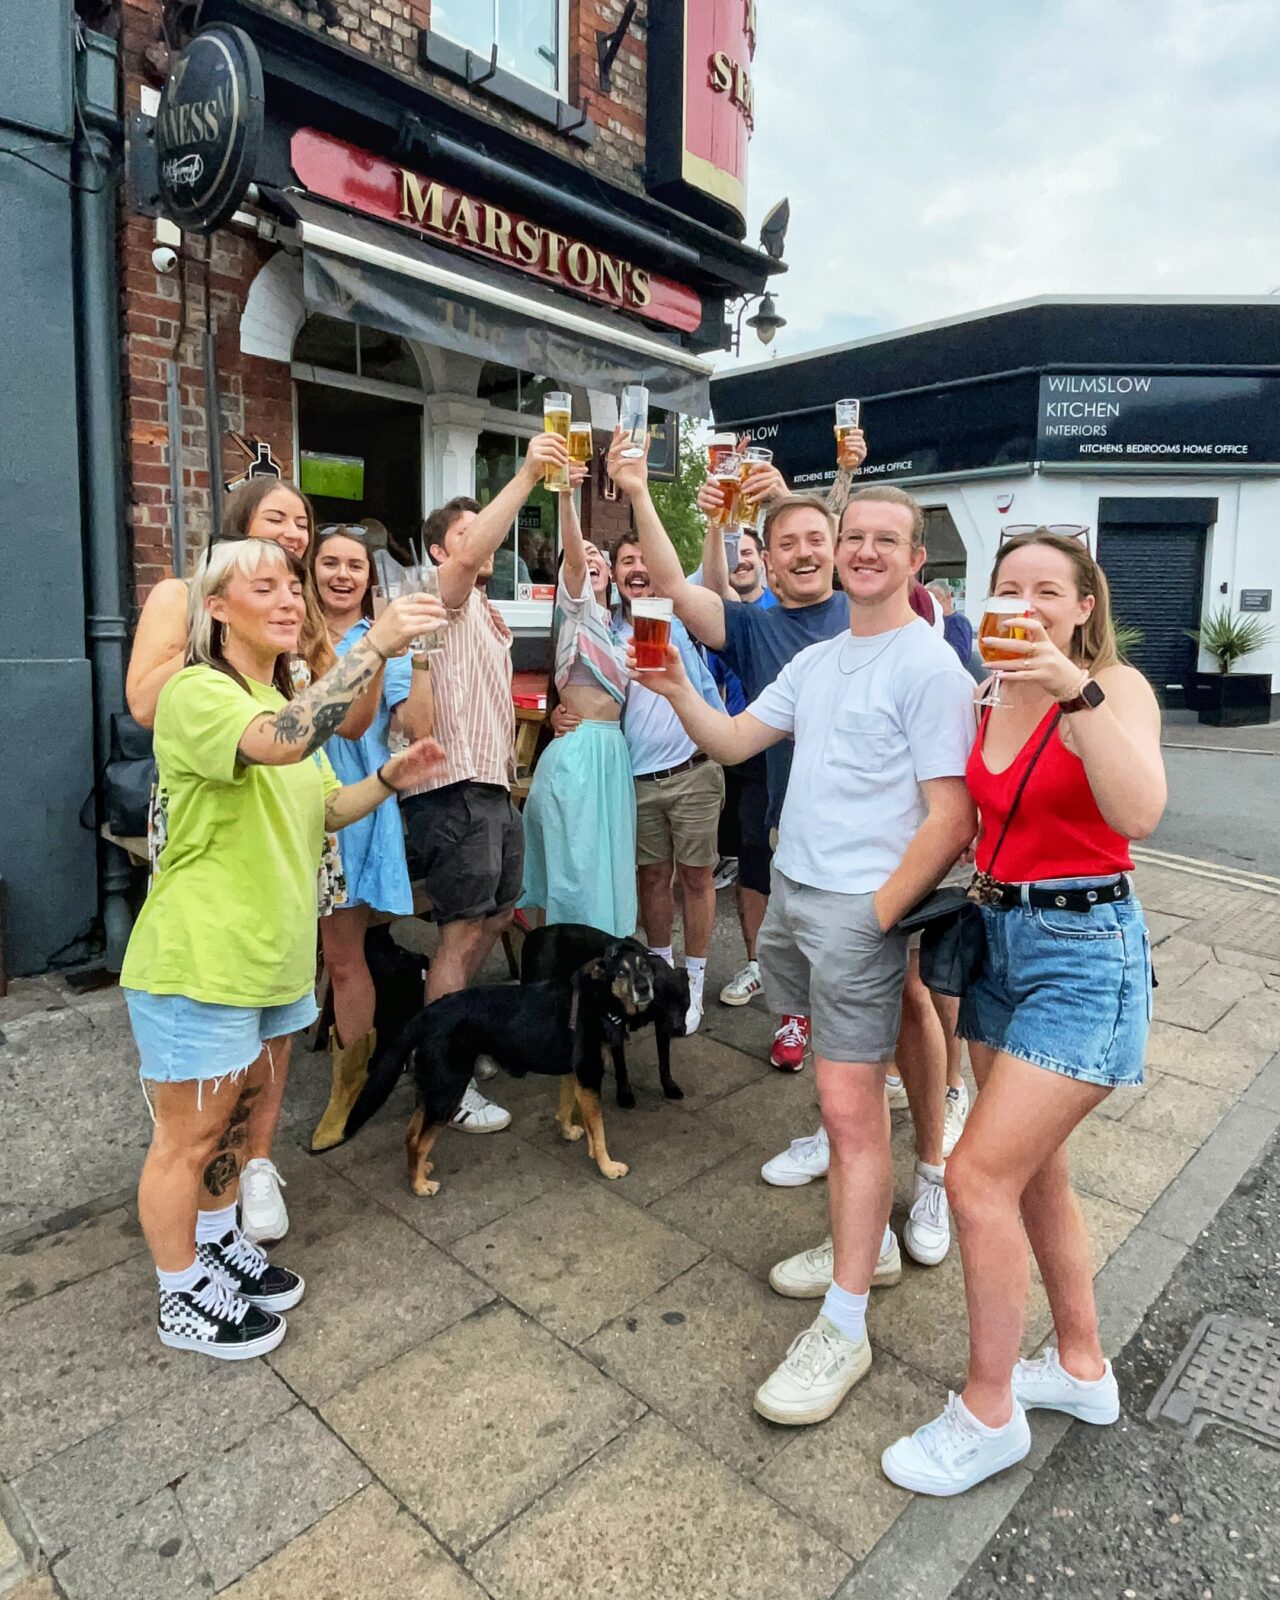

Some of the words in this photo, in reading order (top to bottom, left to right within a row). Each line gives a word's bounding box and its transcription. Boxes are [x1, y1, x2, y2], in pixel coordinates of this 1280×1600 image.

[399, 167, 651, 307] MARSTON'S
[1048, 377, 1151, 393] WILMSLOW
[1046, 402, 1120, 417] KITCHEN
[737, 424, 779, 442] MSLOW
[1045, 425, 1108, 436] INTERIORS
[1079, 444, 1124, 454] KITCHENS
[1126, 444, 1181, 454] BEDROOMS
[1182, 445, 1213, 454] HOME
[1214, 445, 1249, 454] OFFICE
[793, 471, 823, 483] KITCHENS
[863, 464, 886, 475] HOME
[886, 460, 913, 472] OFFICE
